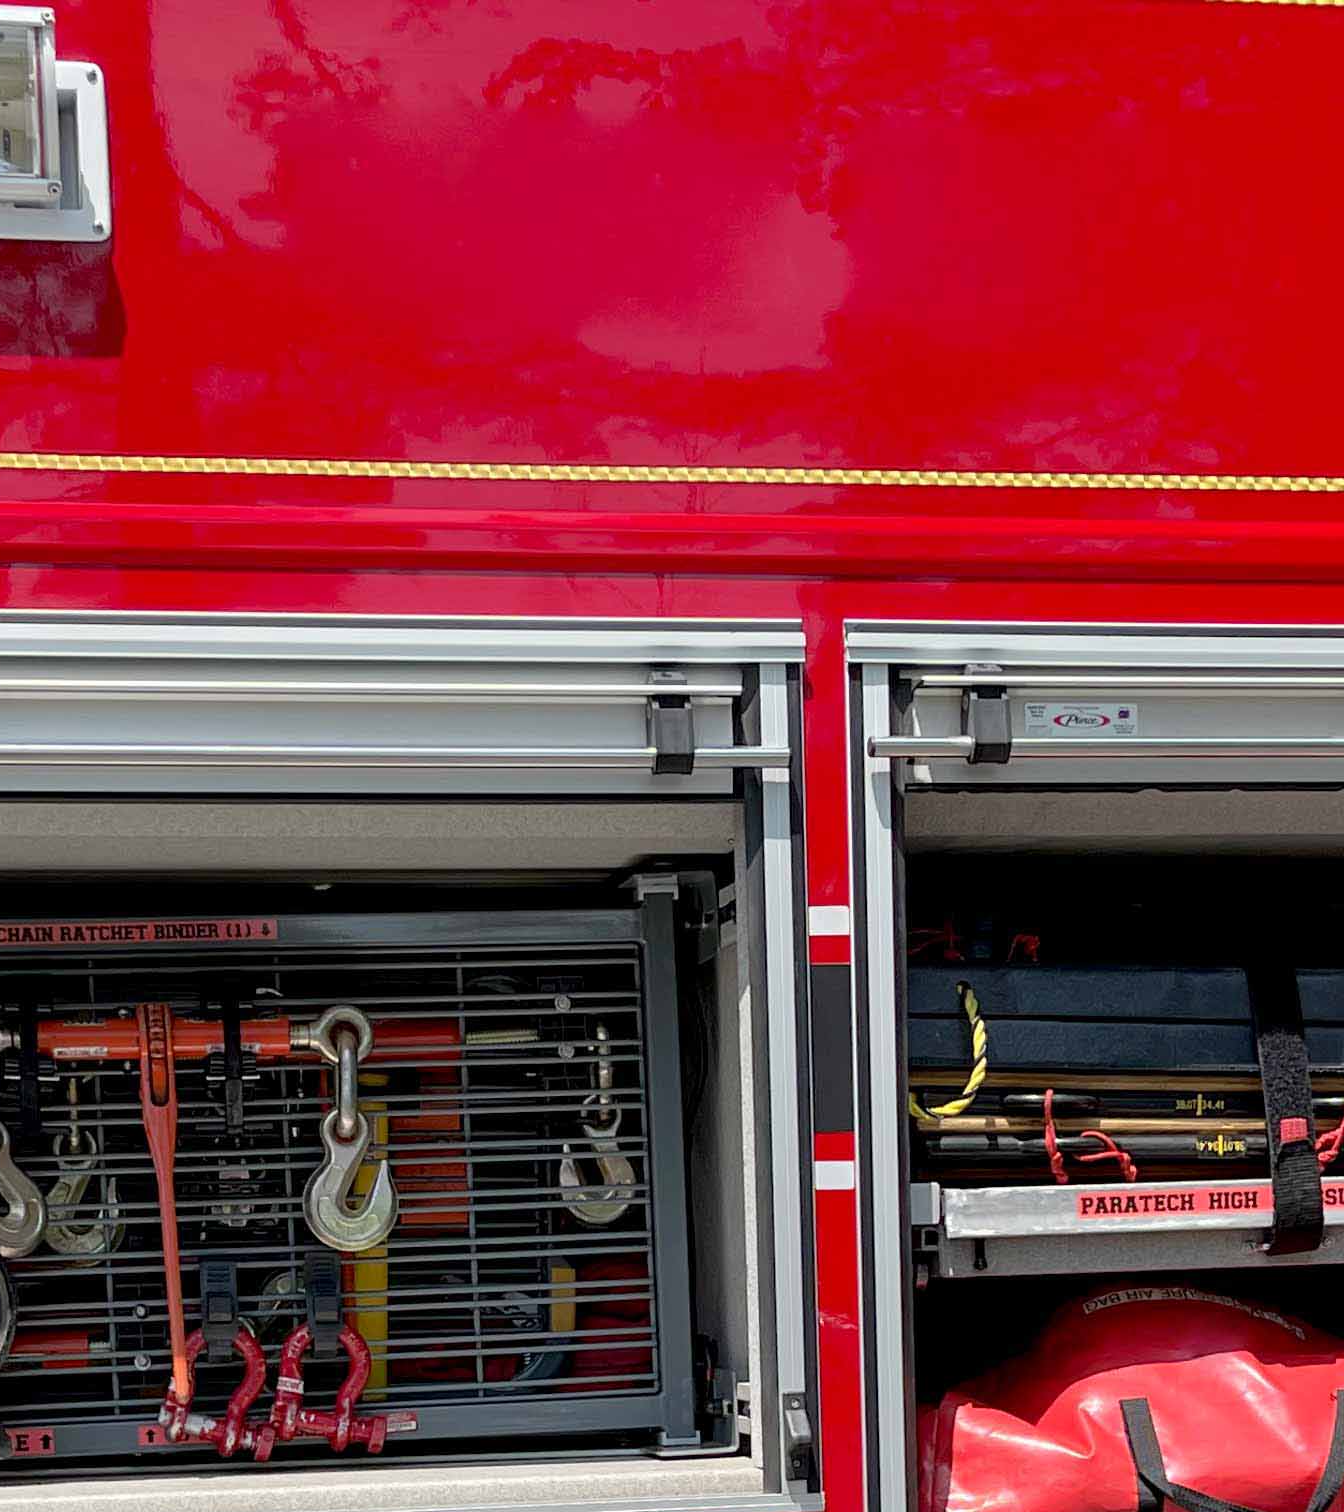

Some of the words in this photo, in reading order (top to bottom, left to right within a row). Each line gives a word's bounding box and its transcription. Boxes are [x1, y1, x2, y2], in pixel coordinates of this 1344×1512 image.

[59, 924, 148, 942] RATCHET
[155, 922, 219, 940] BINDER
[226, 922, 252, 938] (1)
[1080, 1193, 1194, 1215] PARATECH
[1208, 1190, 1259, 1210] HIGH
